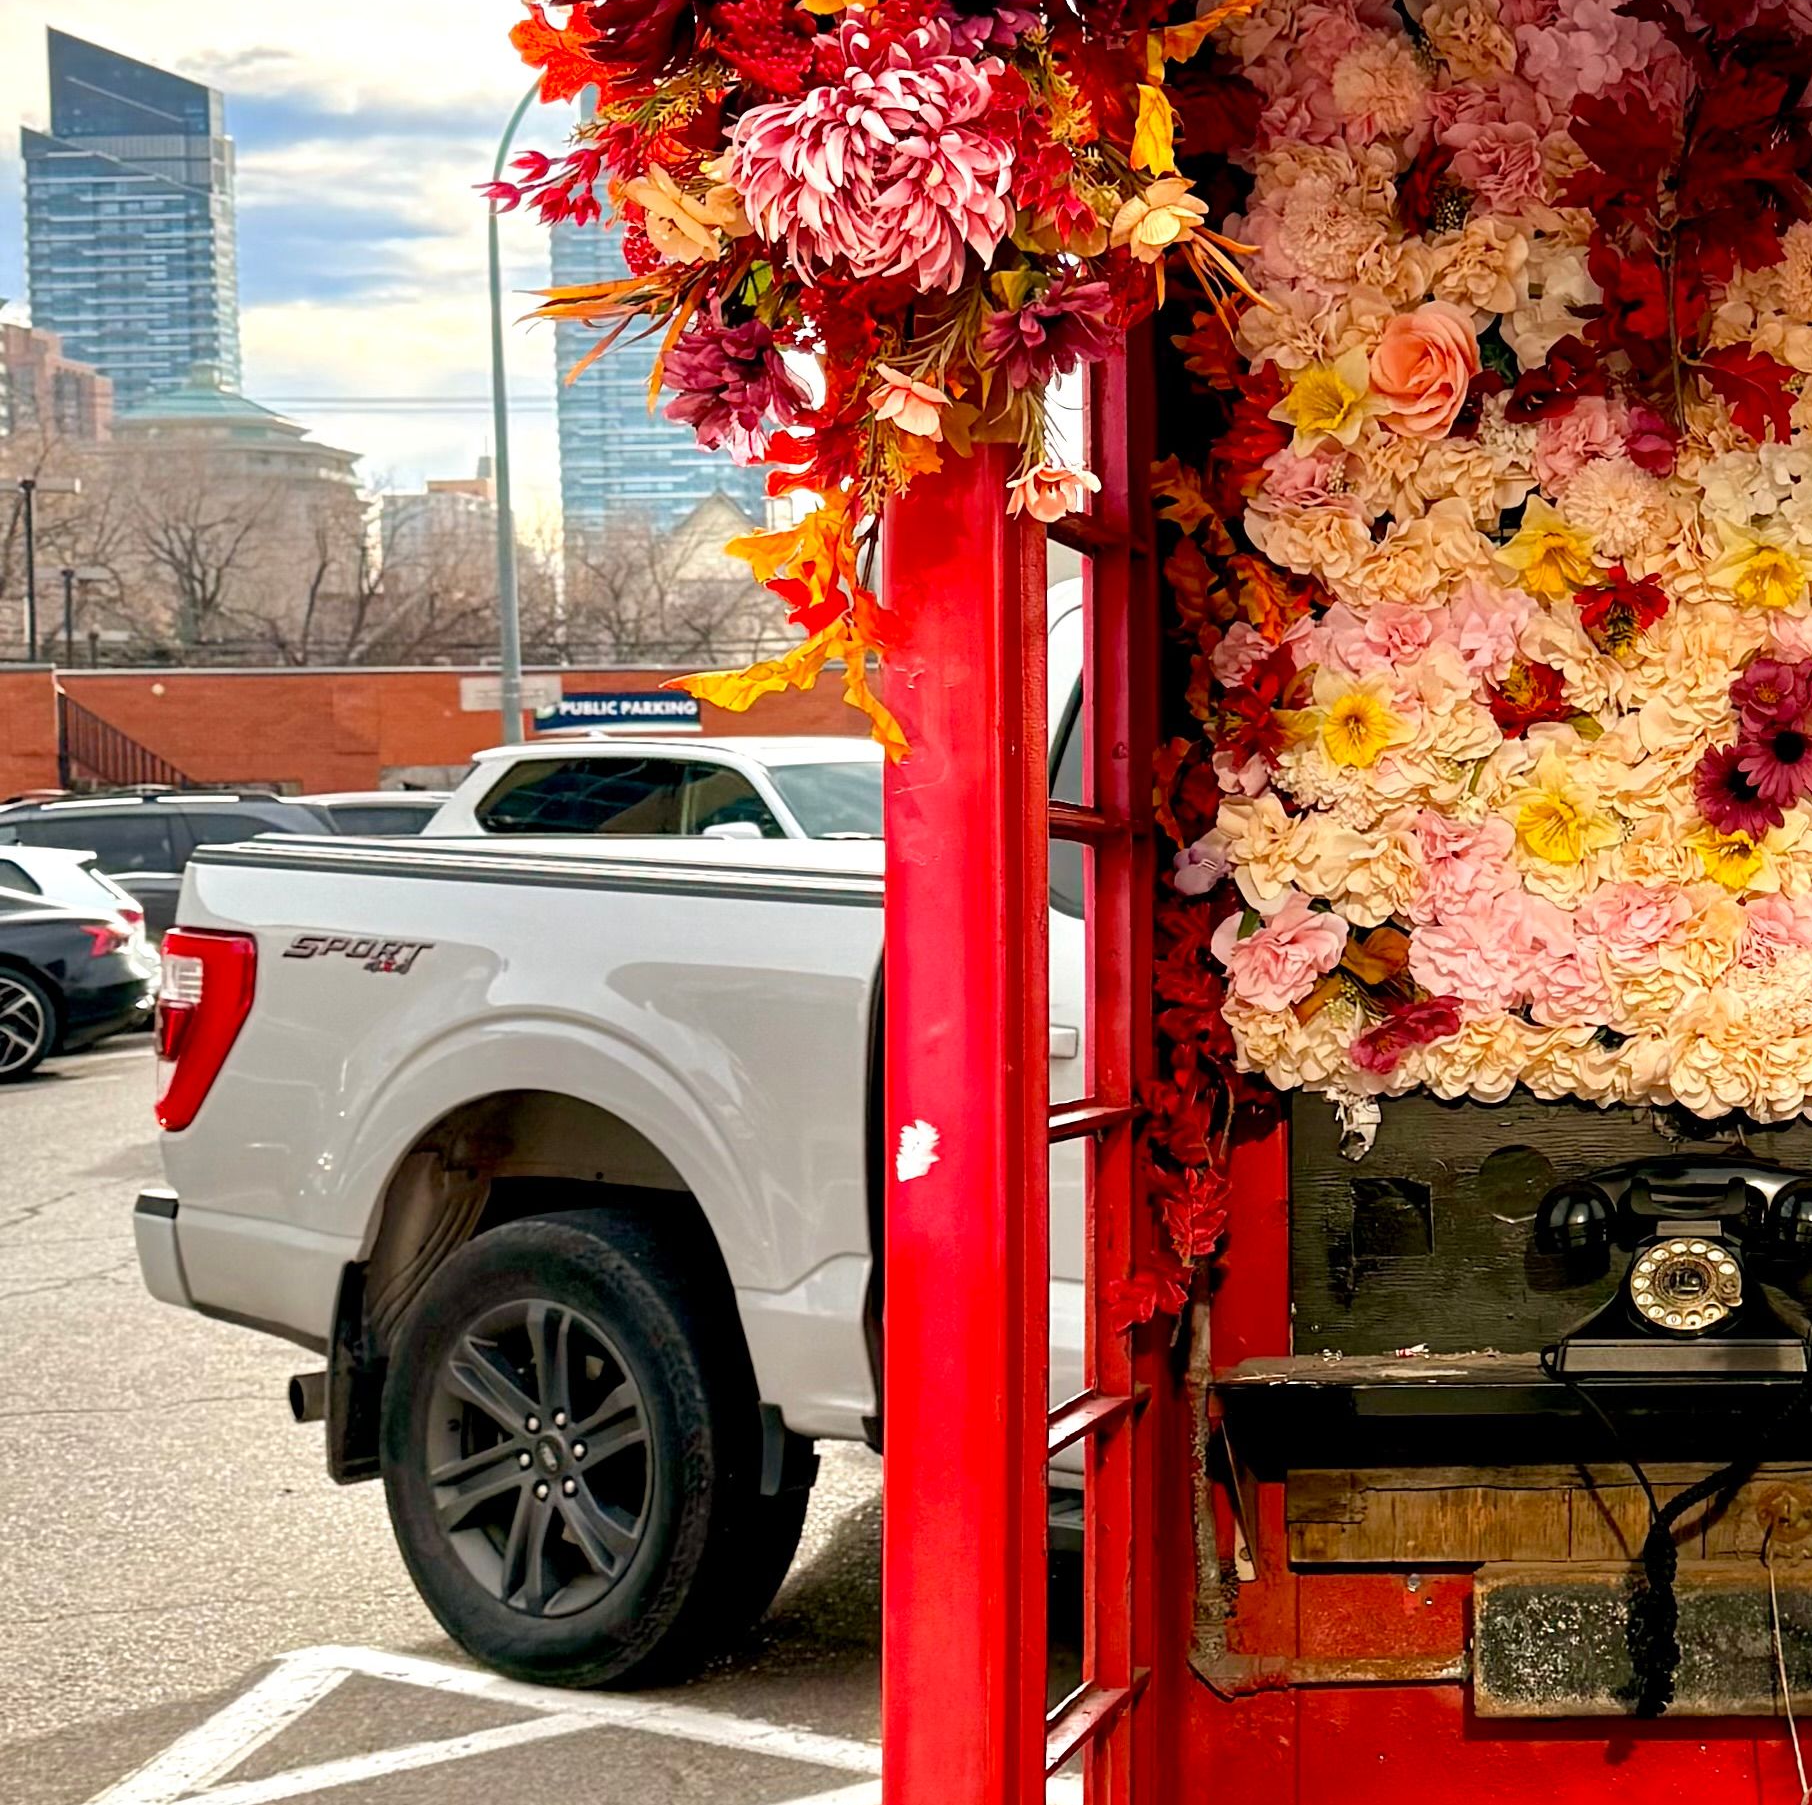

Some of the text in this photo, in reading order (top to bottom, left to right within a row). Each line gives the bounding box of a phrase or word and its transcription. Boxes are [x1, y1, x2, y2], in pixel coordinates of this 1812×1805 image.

[560, 700, 698, 715] PUBLIC PARKING
[282, 935, 435, 970] SPORT
